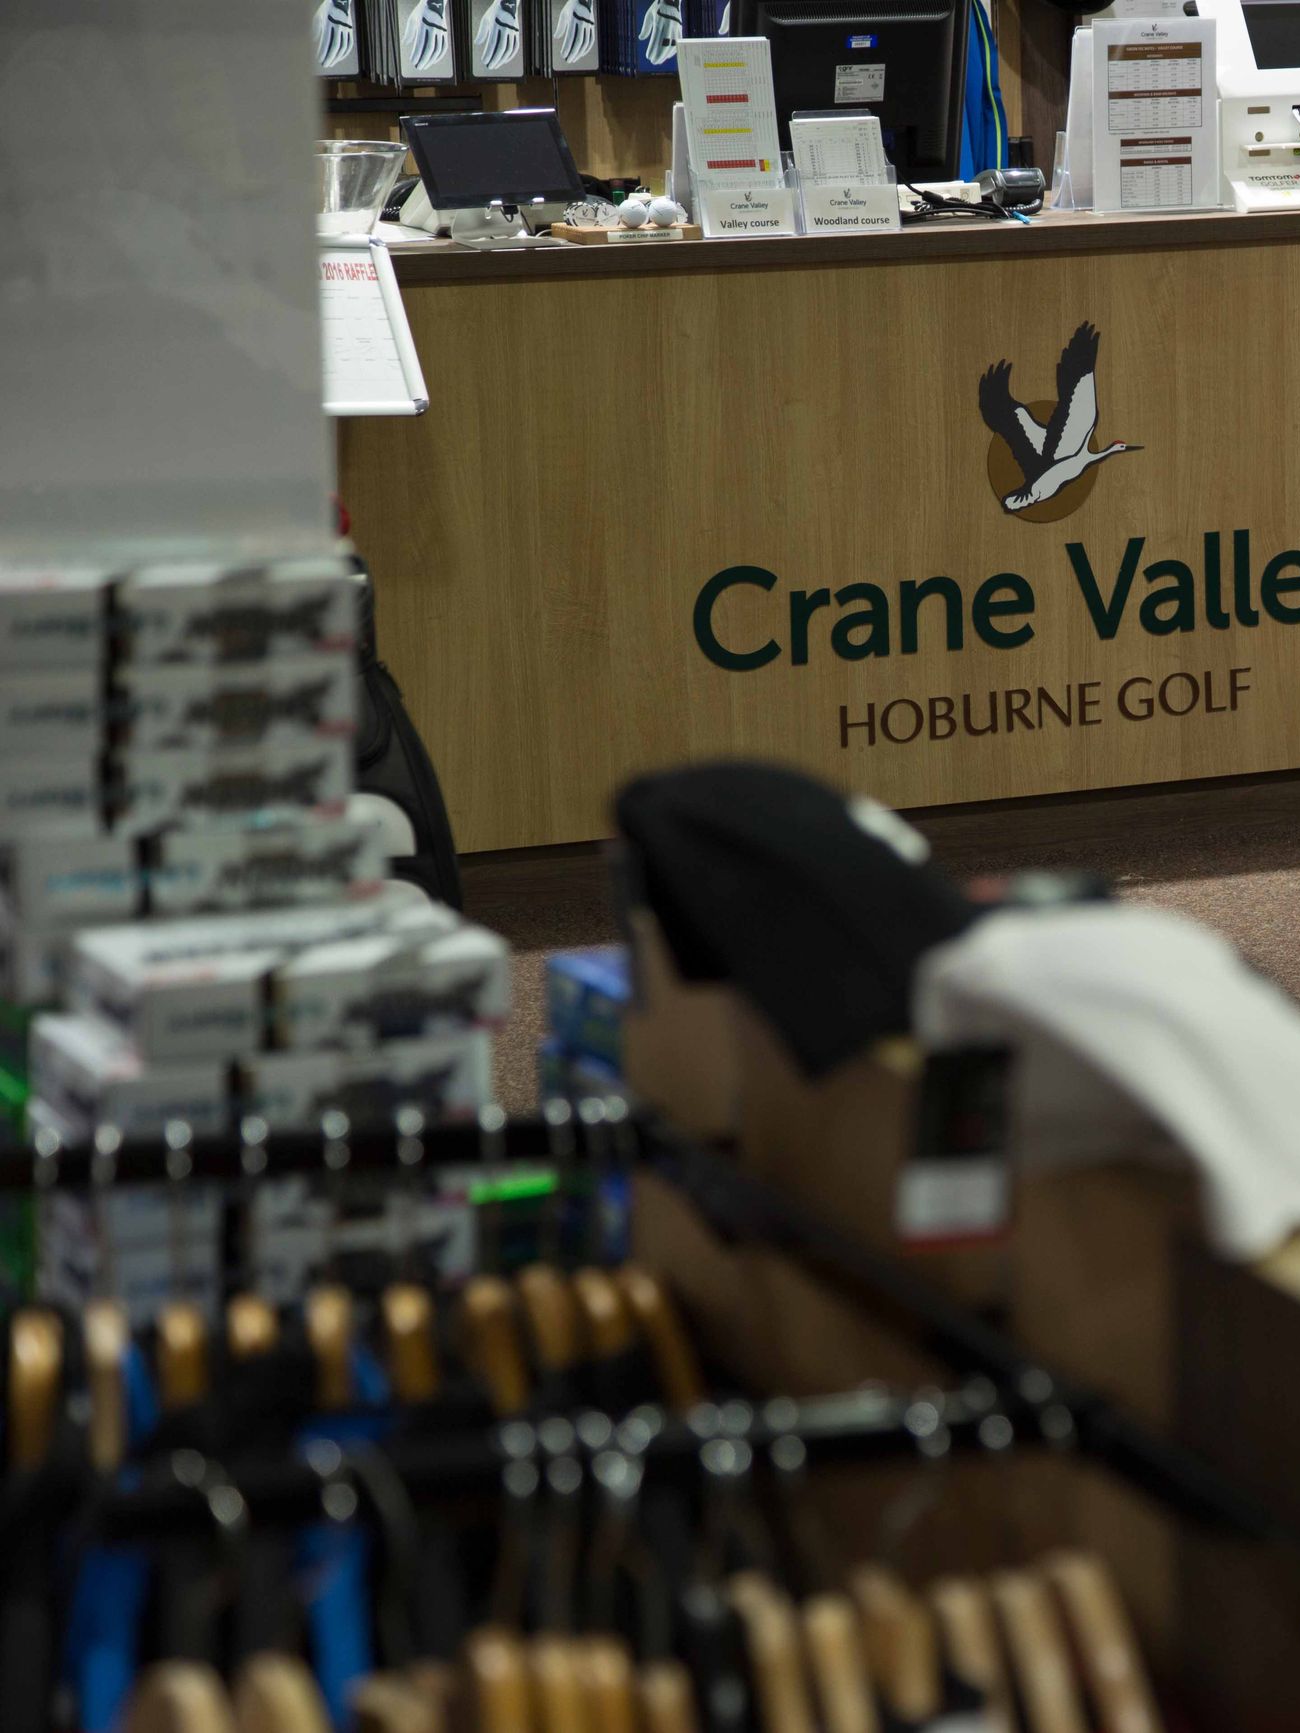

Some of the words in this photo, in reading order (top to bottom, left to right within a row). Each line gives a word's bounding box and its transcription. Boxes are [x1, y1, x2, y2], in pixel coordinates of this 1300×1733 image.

[730, 202, 749, 210] Crane
[750, 201, 769, 210] Valley
[849, 199, 867, 207] Valley
[720, 219, 748, 229] Valley
[750, 219, 780, 228] course
[814, 216, 859, 226] Woodland
[860, 217, 890, 225] course
[322, 262, 344, 280] 2016
[692, 564, 1036, 673] Crane
[839, 680, 1103, 749] HOBURNE
[1116, 667, 1253, 723] GOLF
